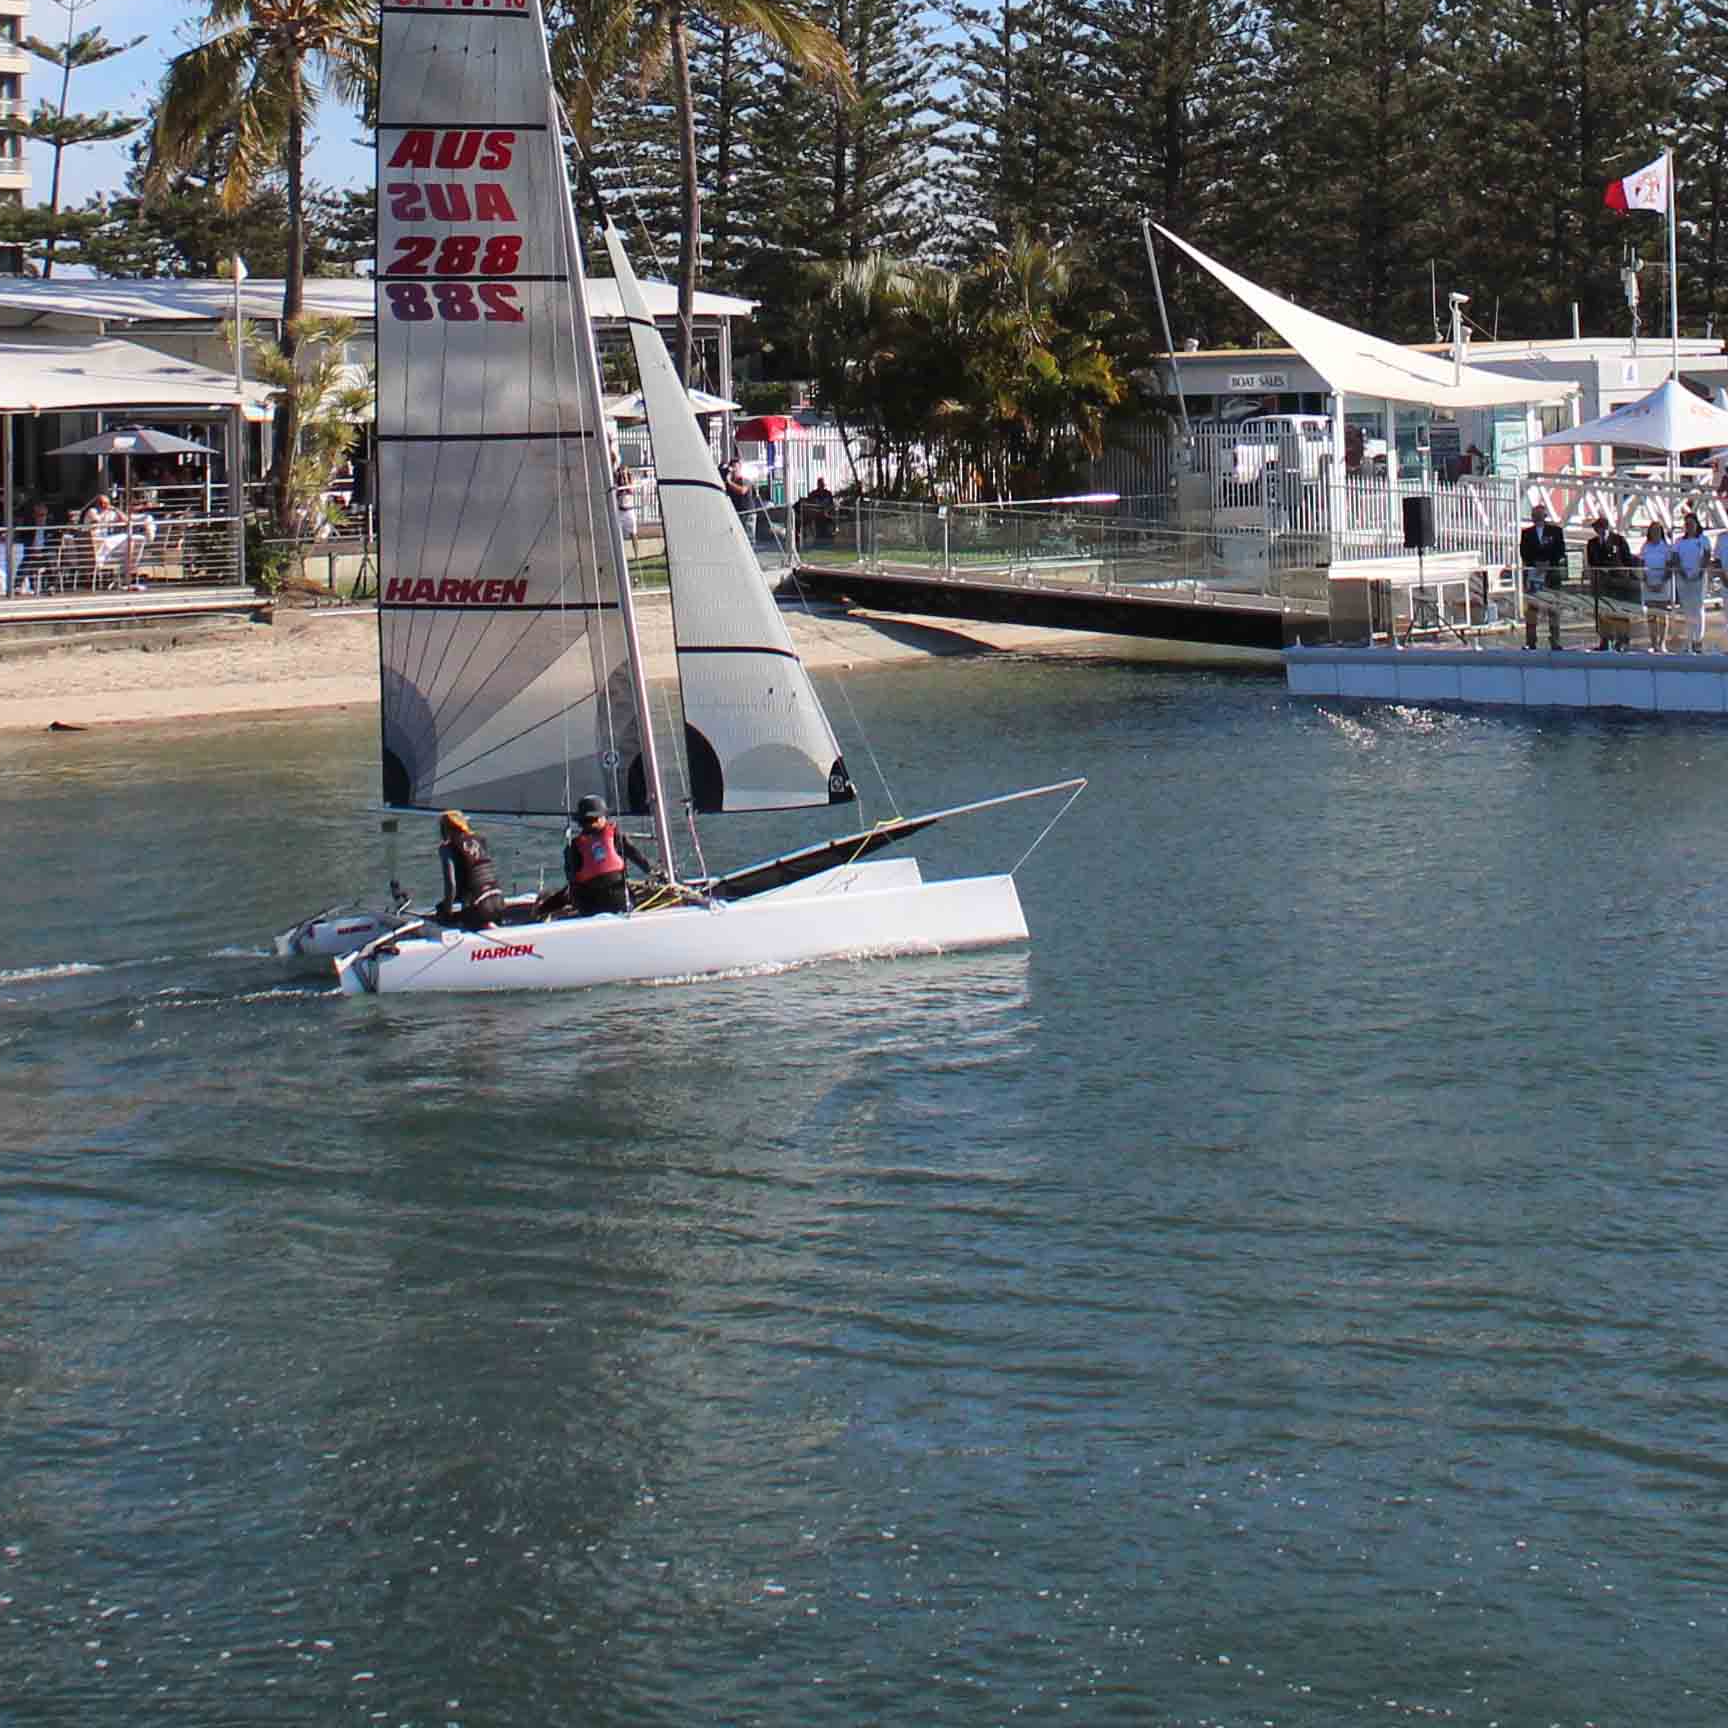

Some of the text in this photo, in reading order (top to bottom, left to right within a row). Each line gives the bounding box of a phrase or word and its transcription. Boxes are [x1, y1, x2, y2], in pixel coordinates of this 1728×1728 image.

[386, 131, 516, 171] AUS
[385, 235, 524, 275] 288
[385, 576, 528, 603] HARKEN
[471, 943, 534, 961] HARKEN
